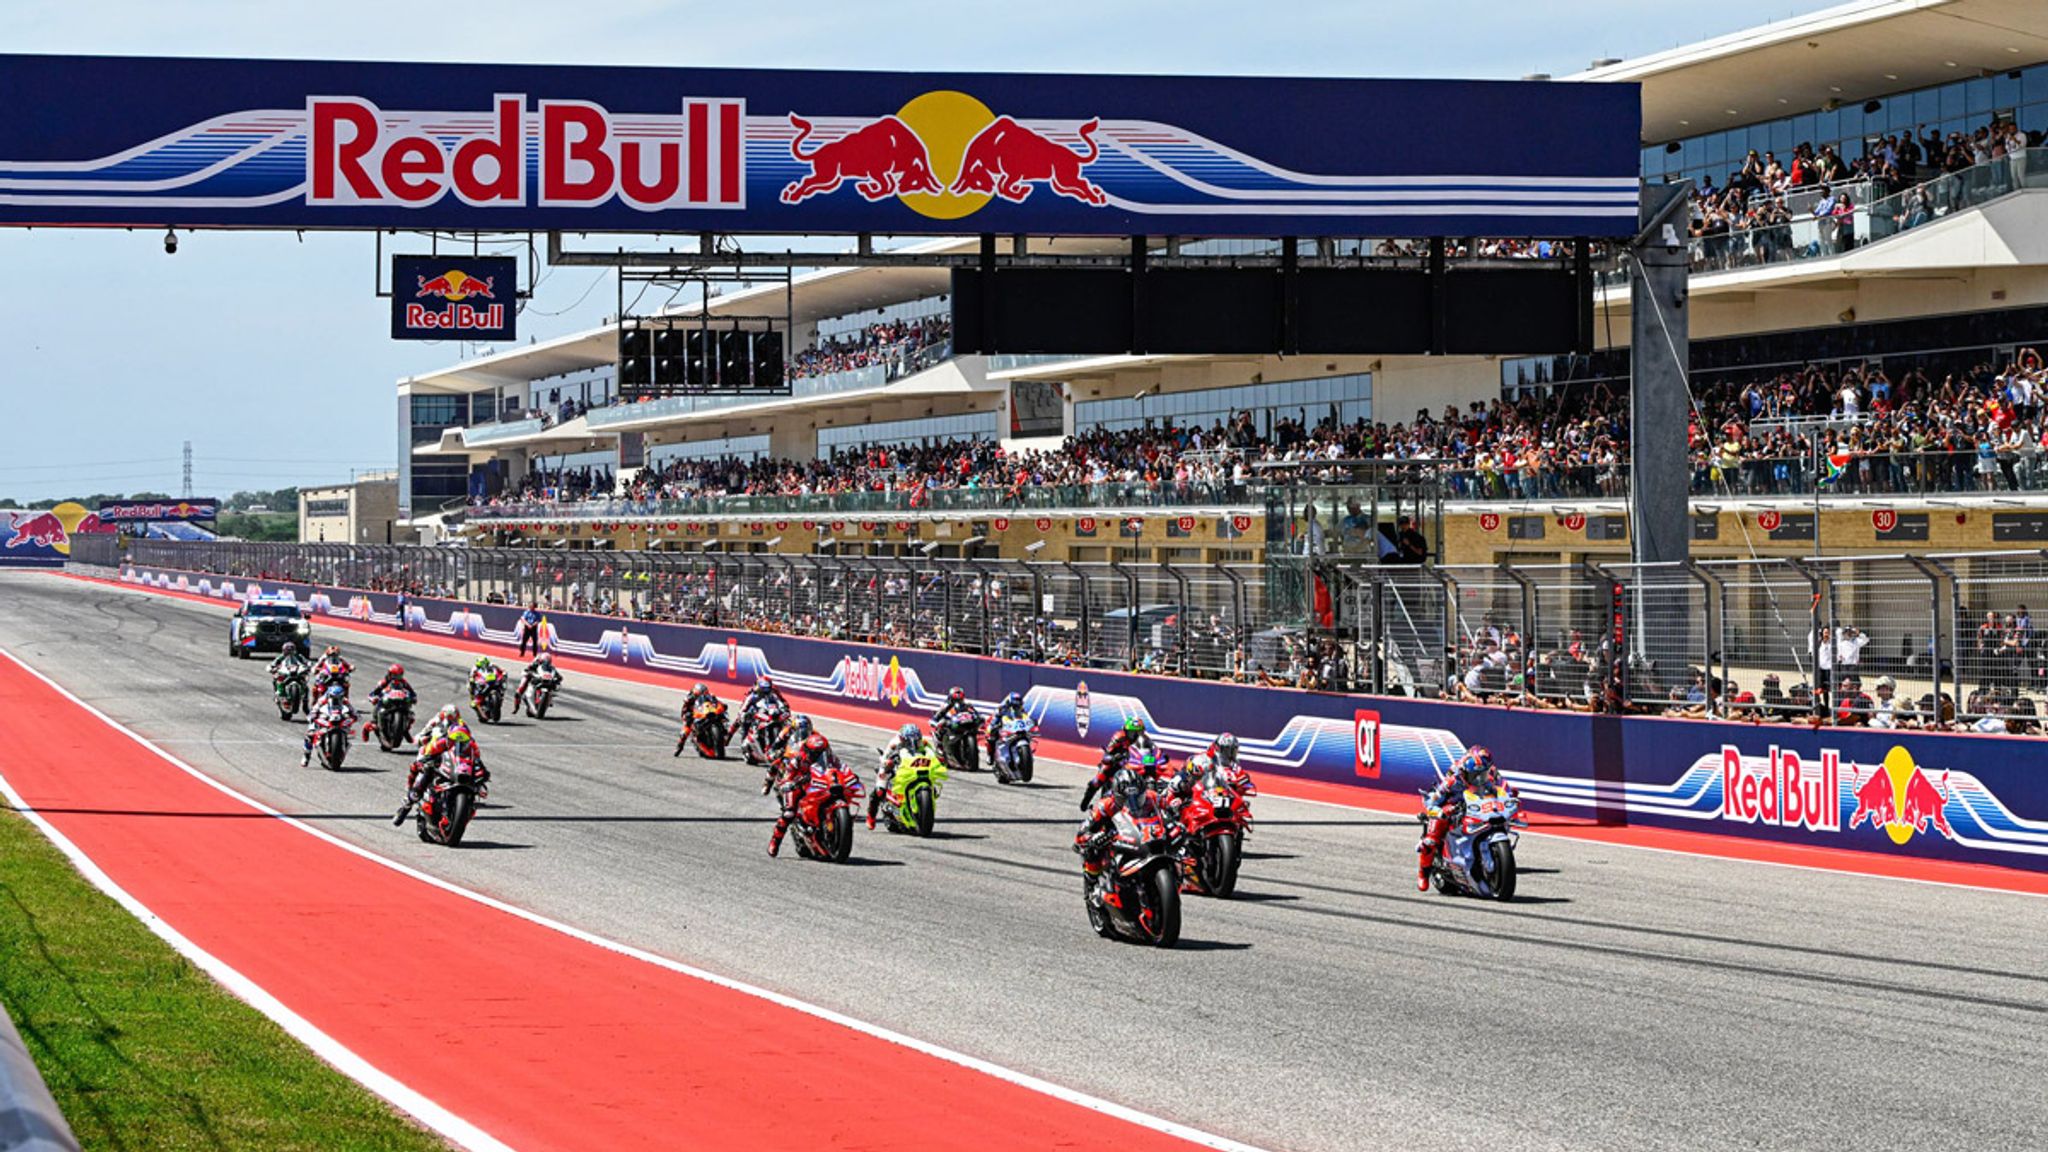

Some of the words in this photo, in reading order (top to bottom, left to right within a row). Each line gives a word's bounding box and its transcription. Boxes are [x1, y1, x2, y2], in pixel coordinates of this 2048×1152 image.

[310, 96, 523, 203] Red
[540, 101, 743, 207] Bull
[408, 304, 454, 328] Red
[458, 304, 503, 328] Bull
[114, 505, 138, 517] Red
[139, 504, 161, 517] Bull
[1083, 518, 1092, 529] 21
[1182, 517, 1192, 529] 23
[1238, 517, 1247, 529] 24
[1484, 516, 1496, 528] 26
[1571, 514, 1580, 527] 27
[1762, 514, 1776, 528] 29
[1877, 512, 1891, 527] 30
[844, 656, 861, 697] Red
[1358, 719, 1376, 766] QT
[1723, 747, 1778, 820] Red
[1782, 751, 1838, 827] Bull
